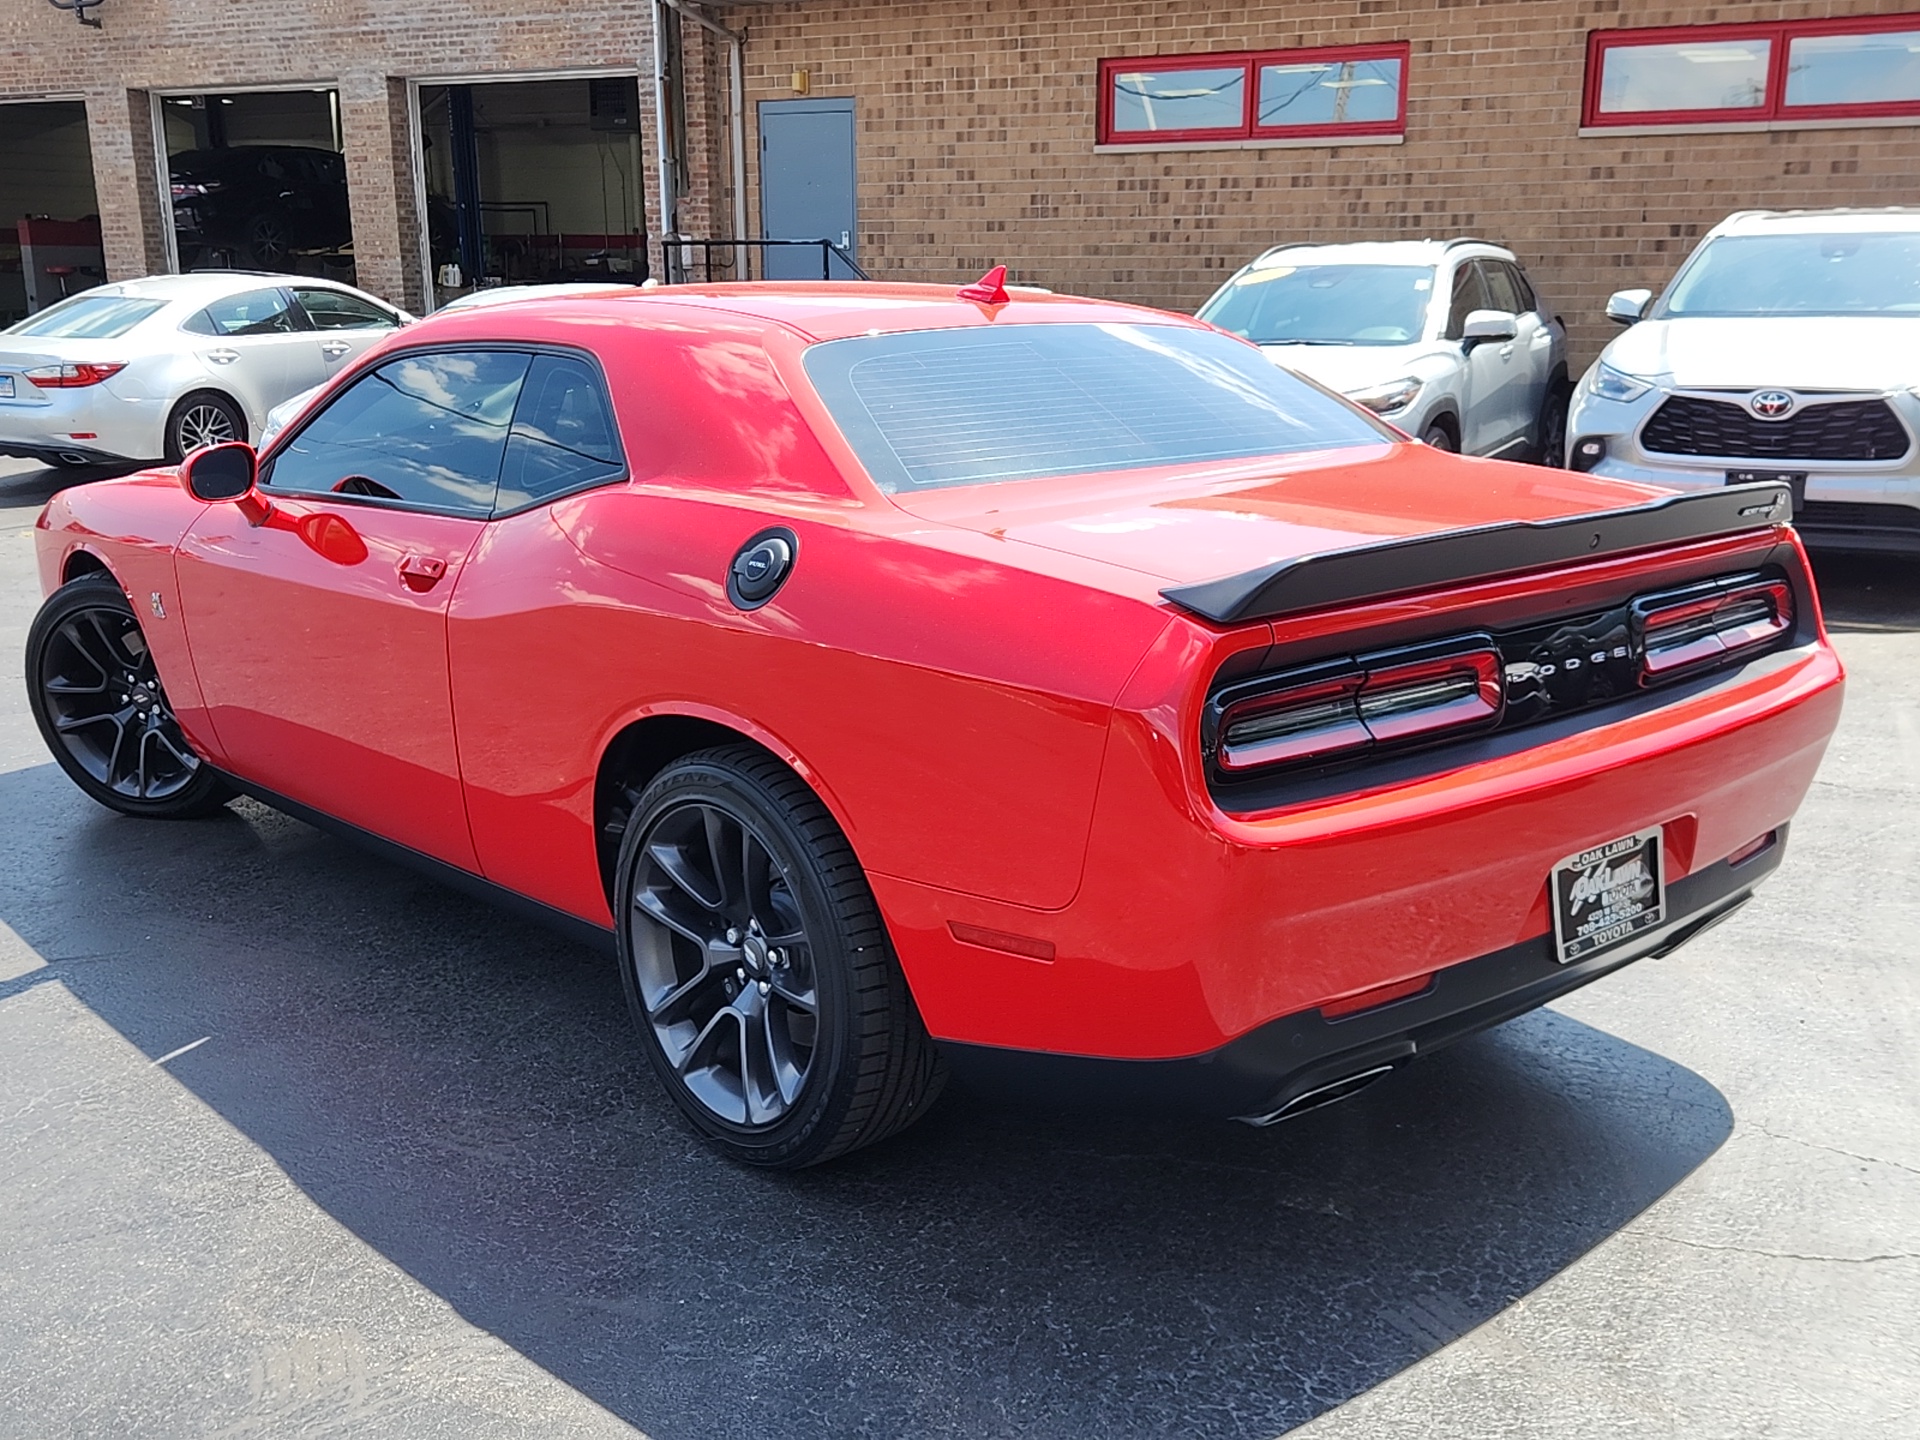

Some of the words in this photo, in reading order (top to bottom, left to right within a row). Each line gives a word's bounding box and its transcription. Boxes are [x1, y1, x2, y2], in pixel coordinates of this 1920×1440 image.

[1512, 646, 1627, 683] DODGE
[1581, 852, 1603, 865] OAK
[1605, 837, 1634, 856] LAWN
[1607, 882, 1637, 902] TOYOTA
[1576, 902, 1643, 936] 708-423-5200
[1592, 921, 1633, 946] TOYOTA
